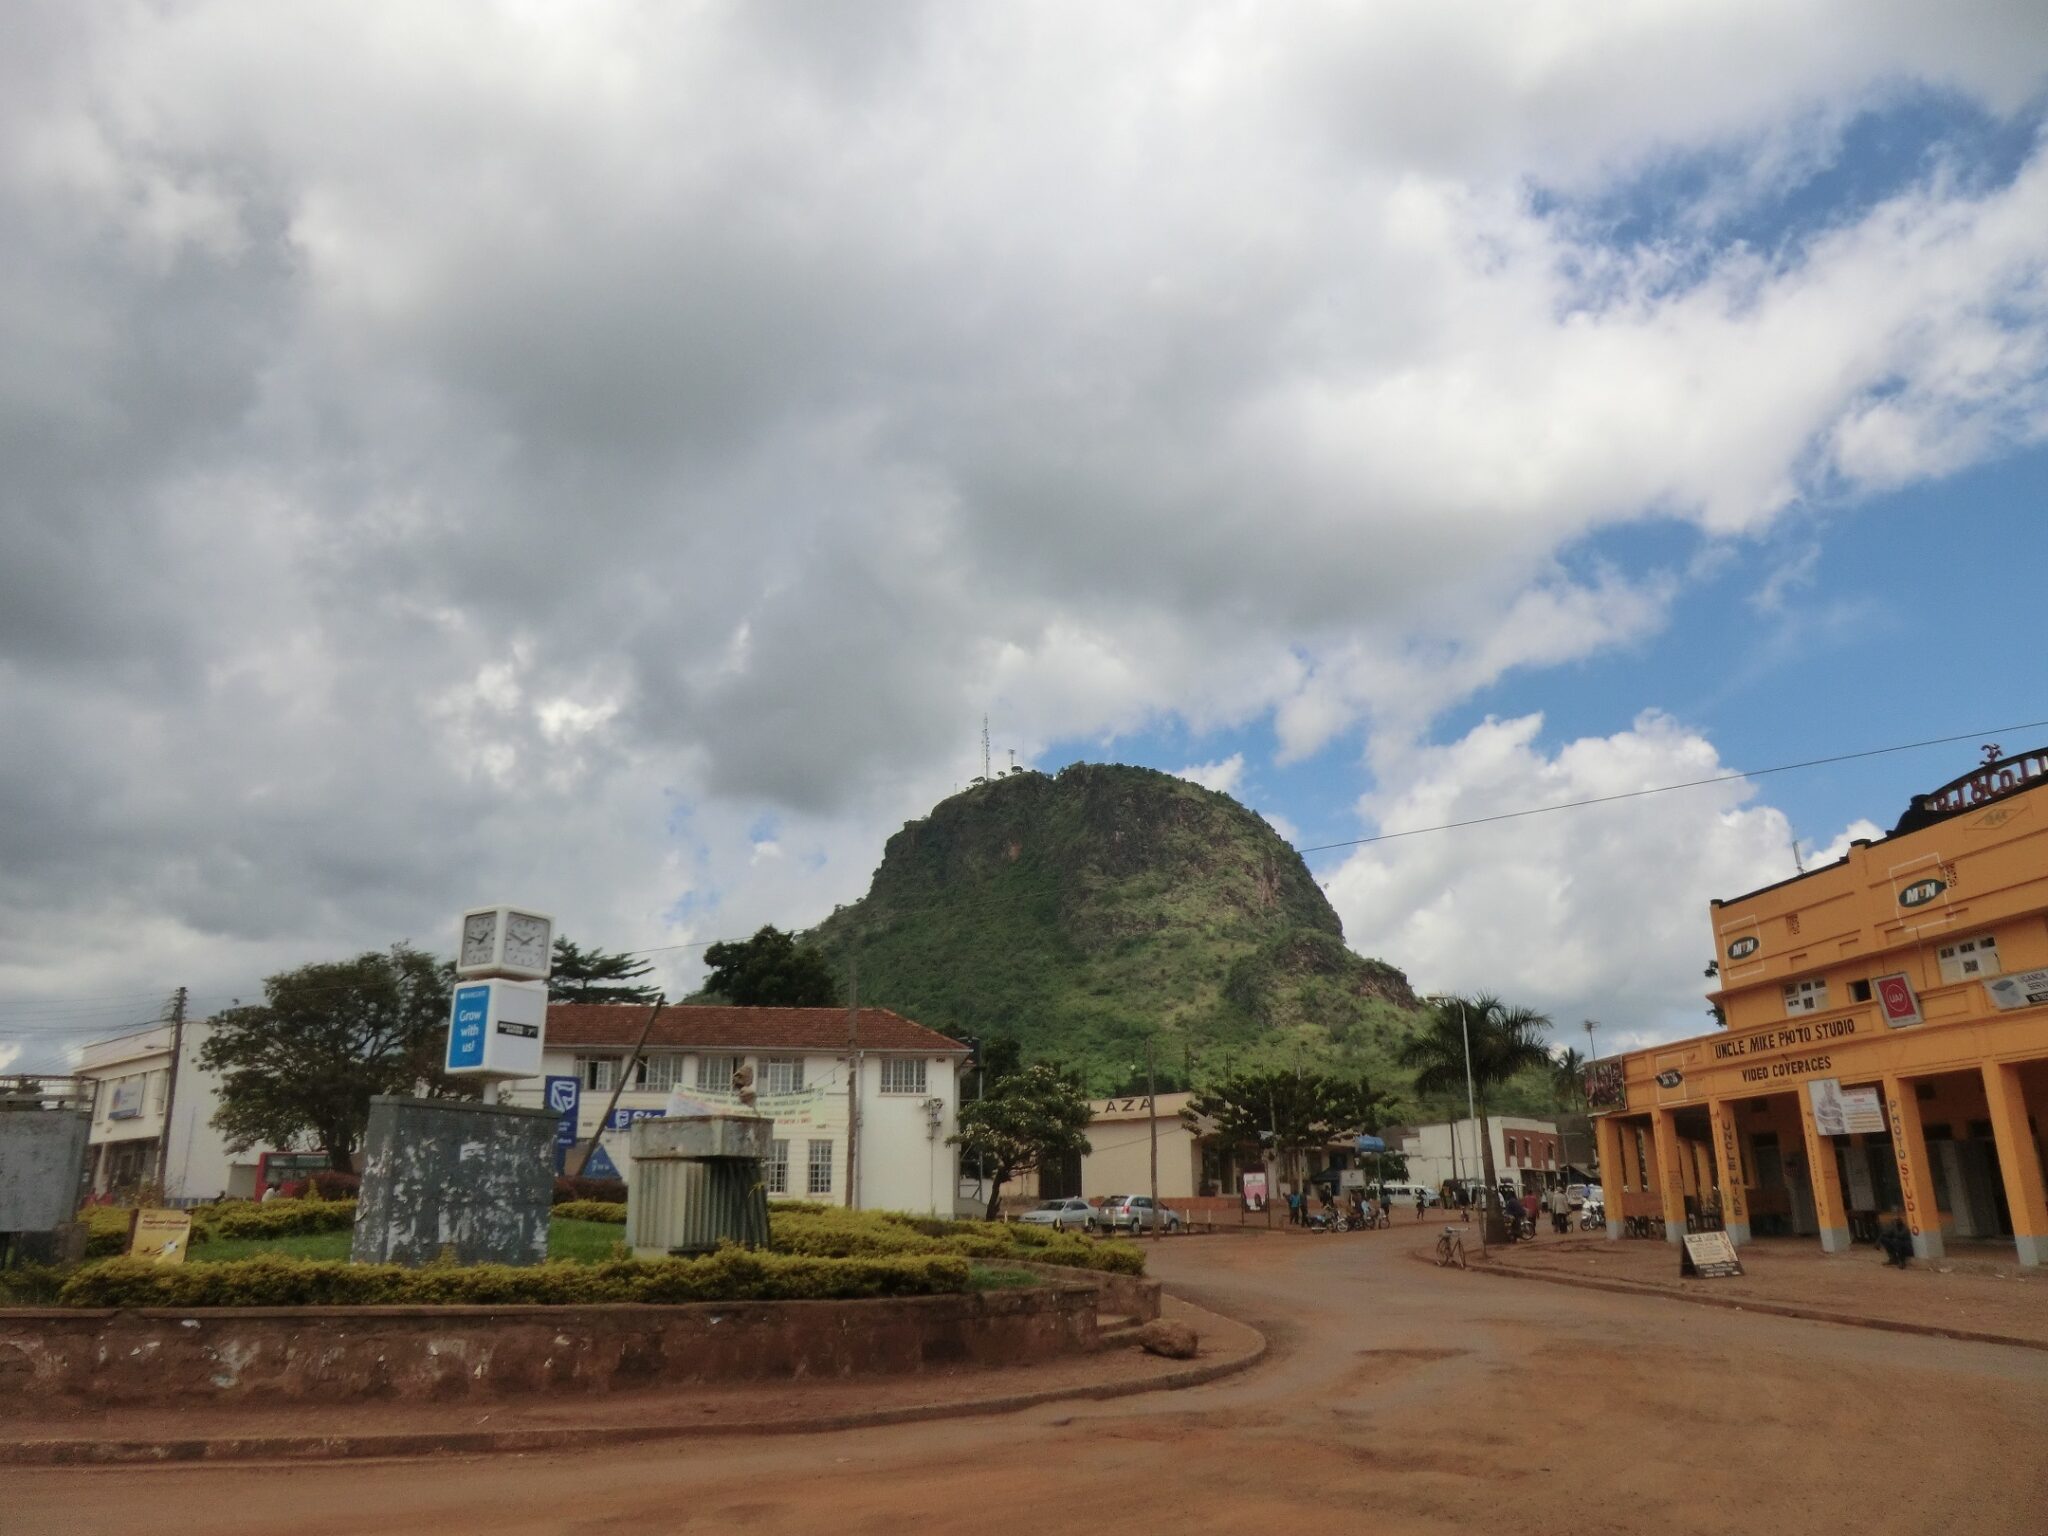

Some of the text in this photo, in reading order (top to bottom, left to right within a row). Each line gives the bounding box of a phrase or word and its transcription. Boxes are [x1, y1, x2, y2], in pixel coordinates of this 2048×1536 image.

[1906, 882, 1936, 904] MTN
[1732, 939, 1754, 957] MTN
[459, 1010, 481, 1022] Grow
[461, 1023, 479, 1037] with
[1714, 1040, 1745, 1059] UNCLE
[1750, 1034, 1776, 1052] MIKE
[1815, 1018, 1855, 1040] STUDIO
[462, 1039, 475, 1053] us!
[1741, 1066, 1769, 1083] VIDEO
[1087, 1098, 1151, 1114] LAZA
[1722, 1120, 1744, 1216] UNCLE MIKE
[1889, 1101, 1920, 1236] PHOTO STUDIO
